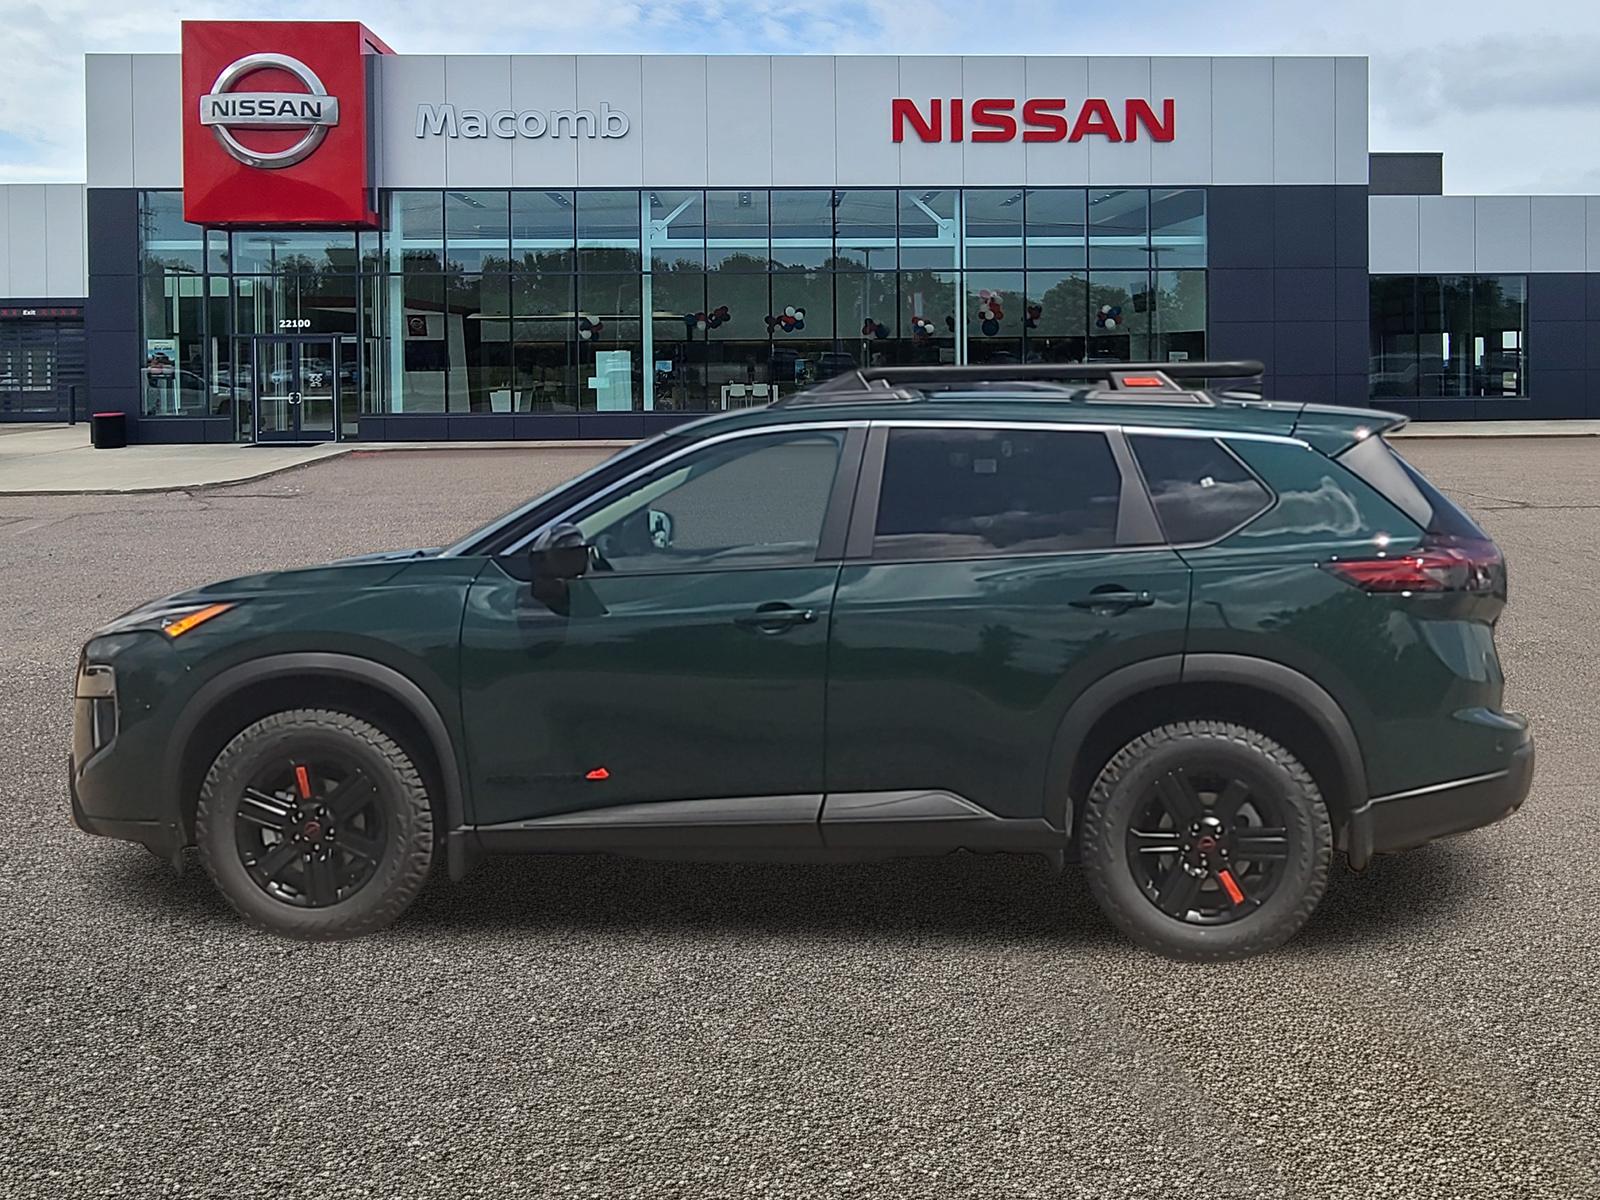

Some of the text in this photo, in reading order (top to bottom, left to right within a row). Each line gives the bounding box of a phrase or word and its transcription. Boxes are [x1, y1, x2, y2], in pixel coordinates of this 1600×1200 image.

[212, 100, 321, 117] NISSAN
[415, 101, 630, 139] Macomb
[892, 98, 1175, 142] NISSAN
[279, 319, 311, 328] 22100
